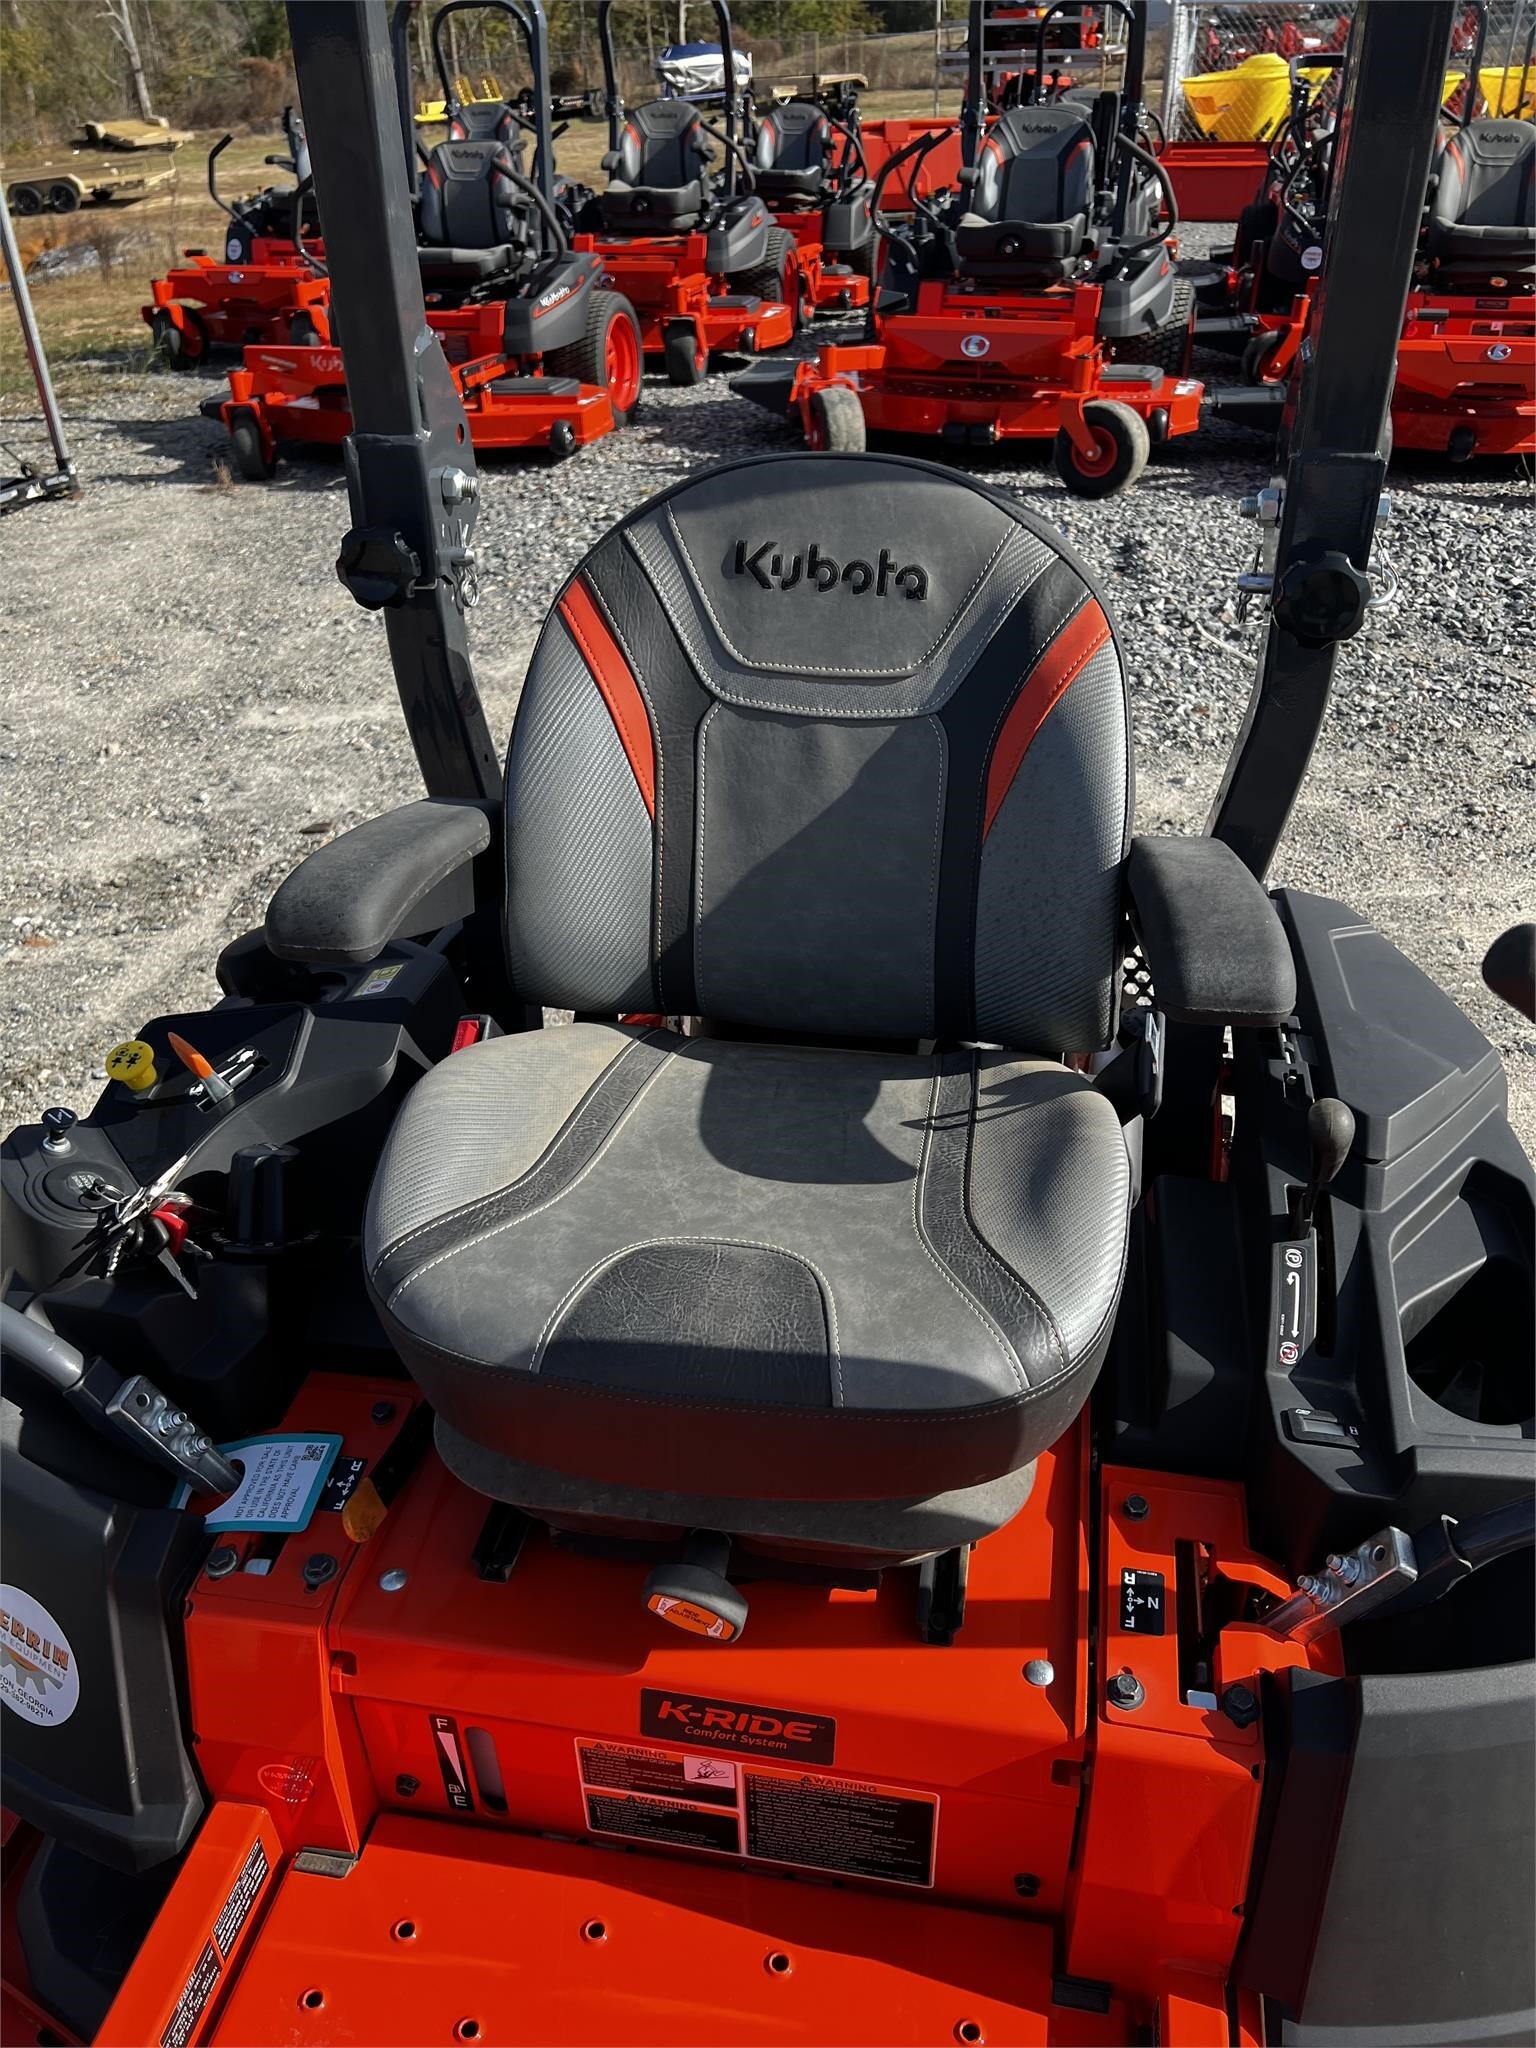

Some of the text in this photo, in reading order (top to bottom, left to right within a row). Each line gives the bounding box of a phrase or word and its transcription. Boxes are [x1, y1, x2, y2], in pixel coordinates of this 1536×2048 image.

[310, 354, 344, 372] Kub
[734, 539, 929, 601] Kubota
[351, 1461, 362, 1471] R
[234, 1506, 245, 1518] NOT
[241, 1474, 260, 1504] APPROVED
[257, 1483, 277, 1518] CALIFORNIA
[280, 1486, 300, 1519] APPROVAL
[268, 1502, 282, 1518] DOES
[333, 1499, 345, 1510] F
[1124, 1572, 1136, 1585] R
[1147, 1596, 1159, 1610] N
[1124, 1616, 1135, 1628] F
[10, 1637, 67, 1681] EQUIPMENT
[18, 1688, 54, 1717] GEORGIA
[436, 1718, 448, 1729] F
[657, 1700, 818, 1742] K-RIDE
[684, 1726, 787, 1750] Comfort System
[606, 1744, 668, 1760] WARNING
[814, 1776, 877, 1793] WARNING
[453, 1795, 468, 1807] E
[638, 1797, 698, 1811] WARNING
